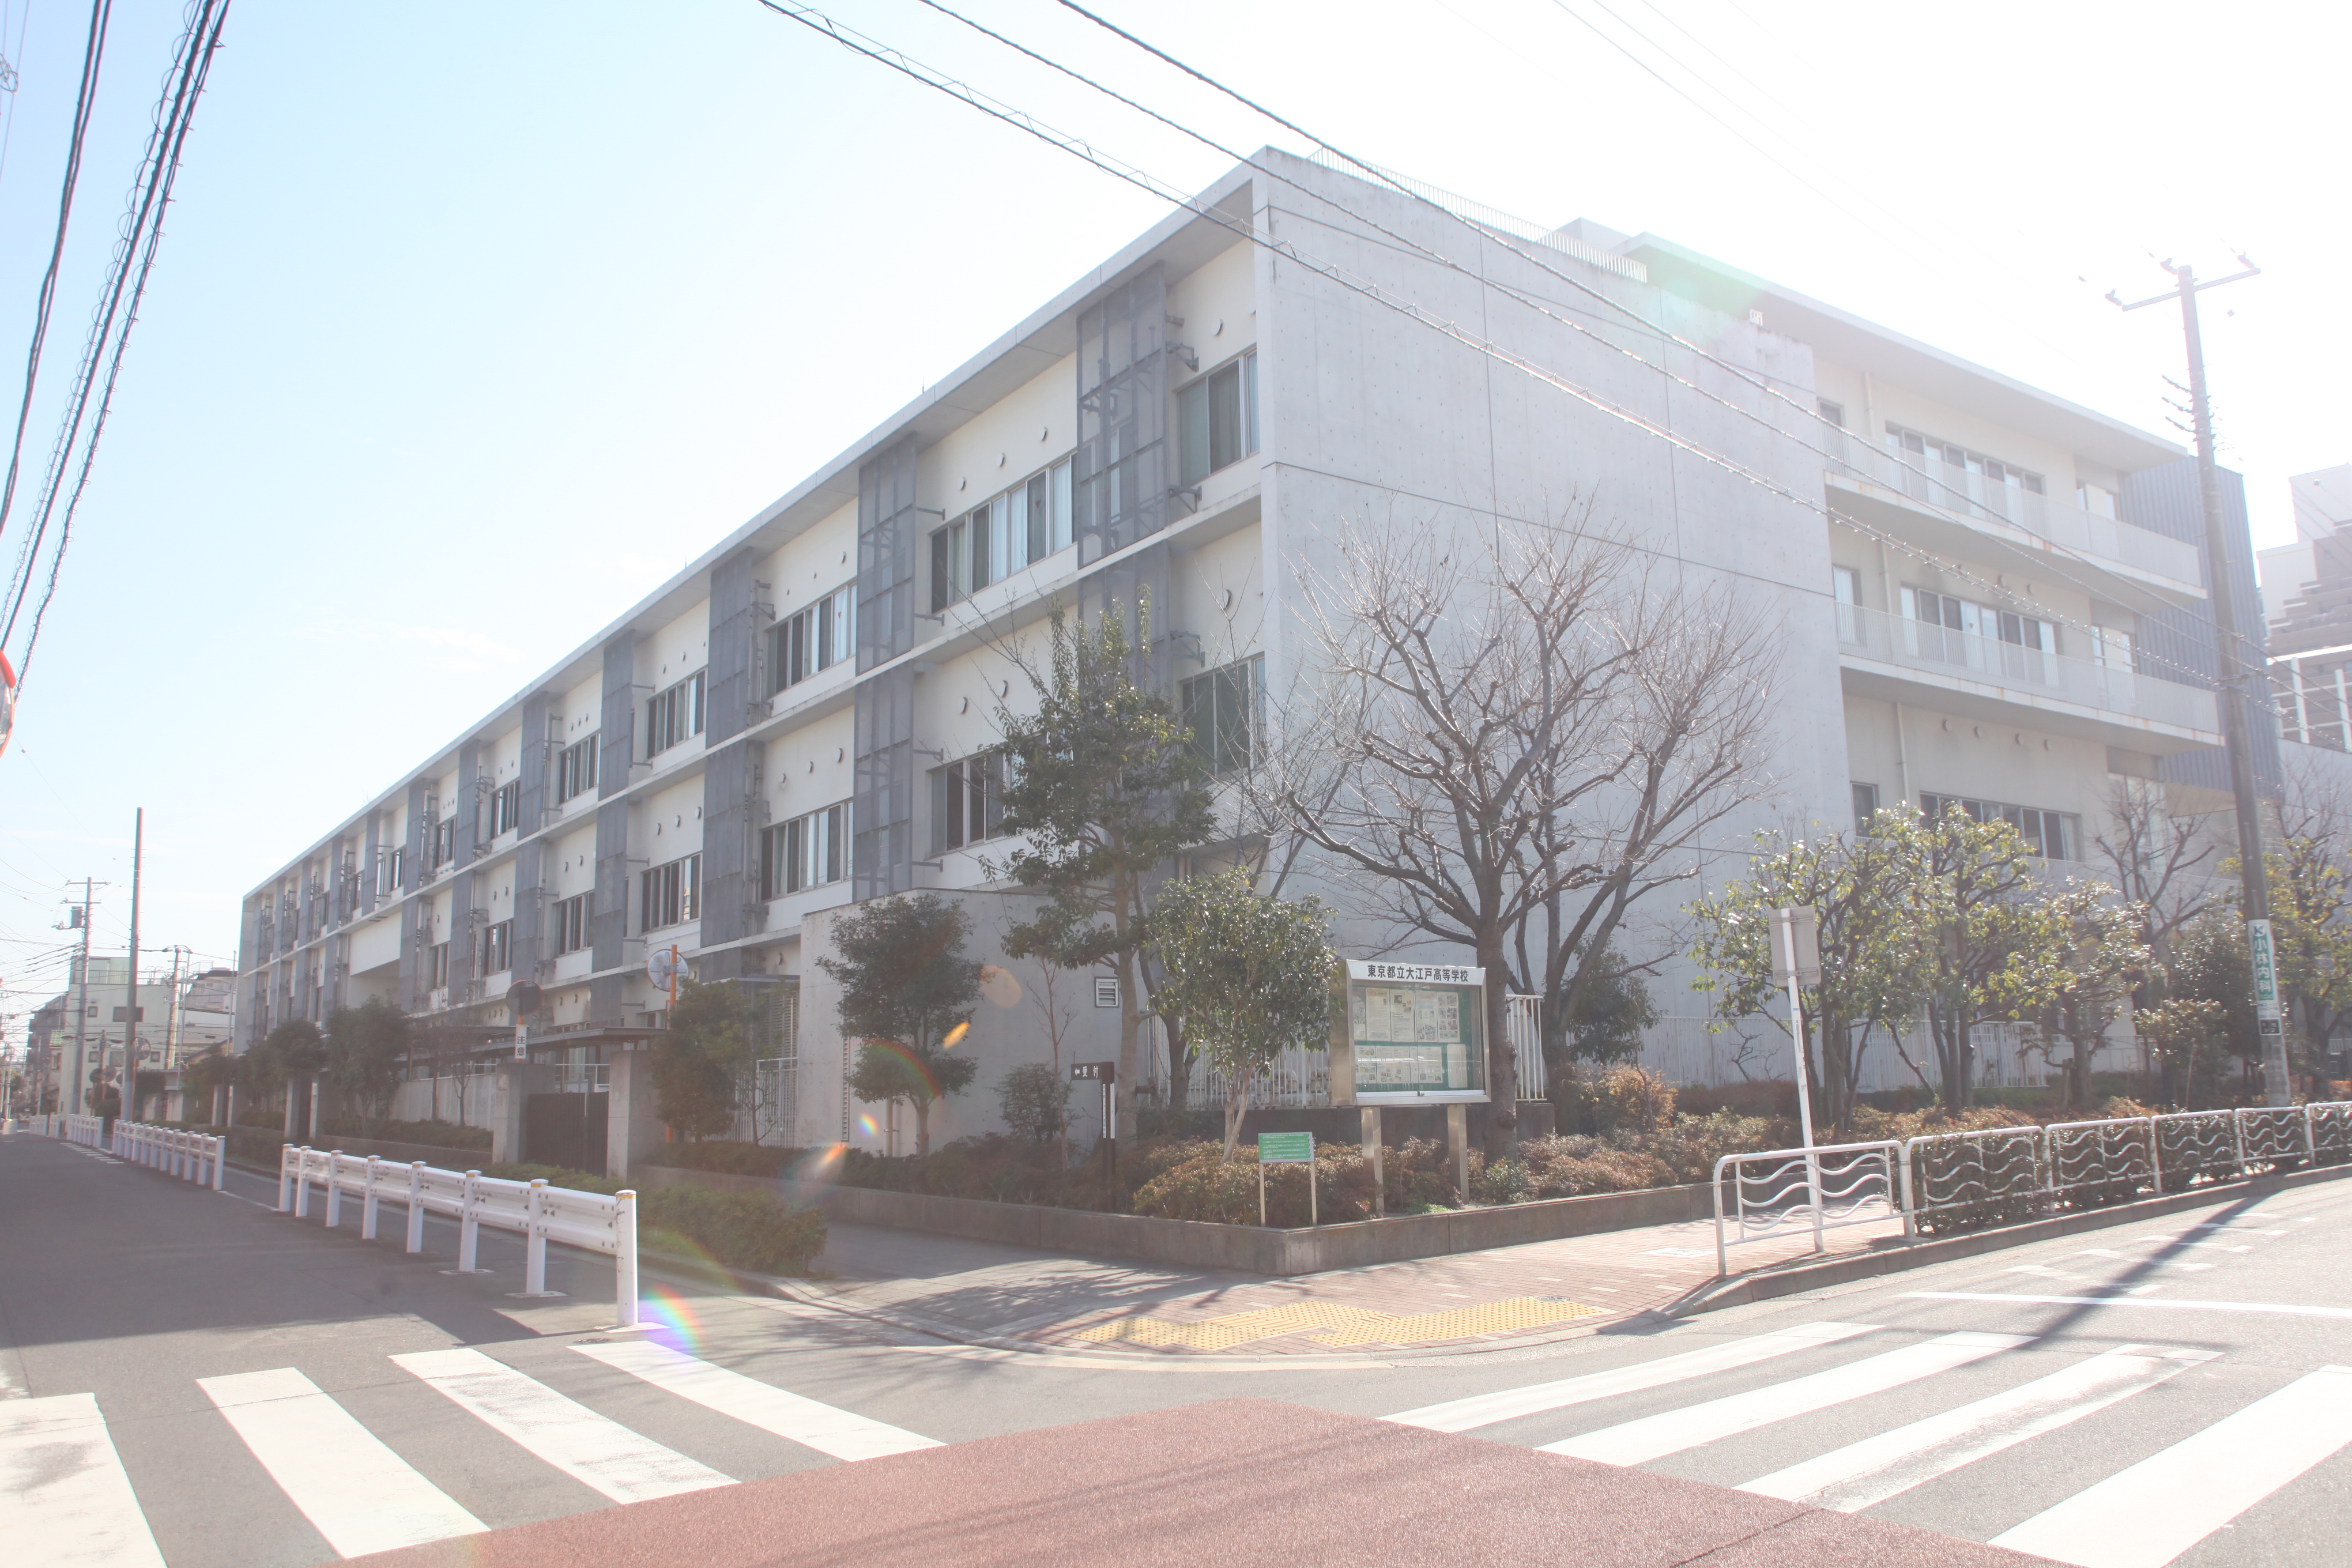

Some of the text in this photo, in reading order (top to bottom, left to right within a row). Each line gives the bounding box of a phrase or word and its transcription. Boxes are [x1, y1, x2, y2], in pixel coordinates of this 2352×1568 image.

[1367, 964, 1468, 982] 東京都立大江戸高等学校
[2254, 938, 2272, 992] 小林内科
[517, 1035, 525, 1056] 注意
[1082, 1065, 1099, 1078] 受付
